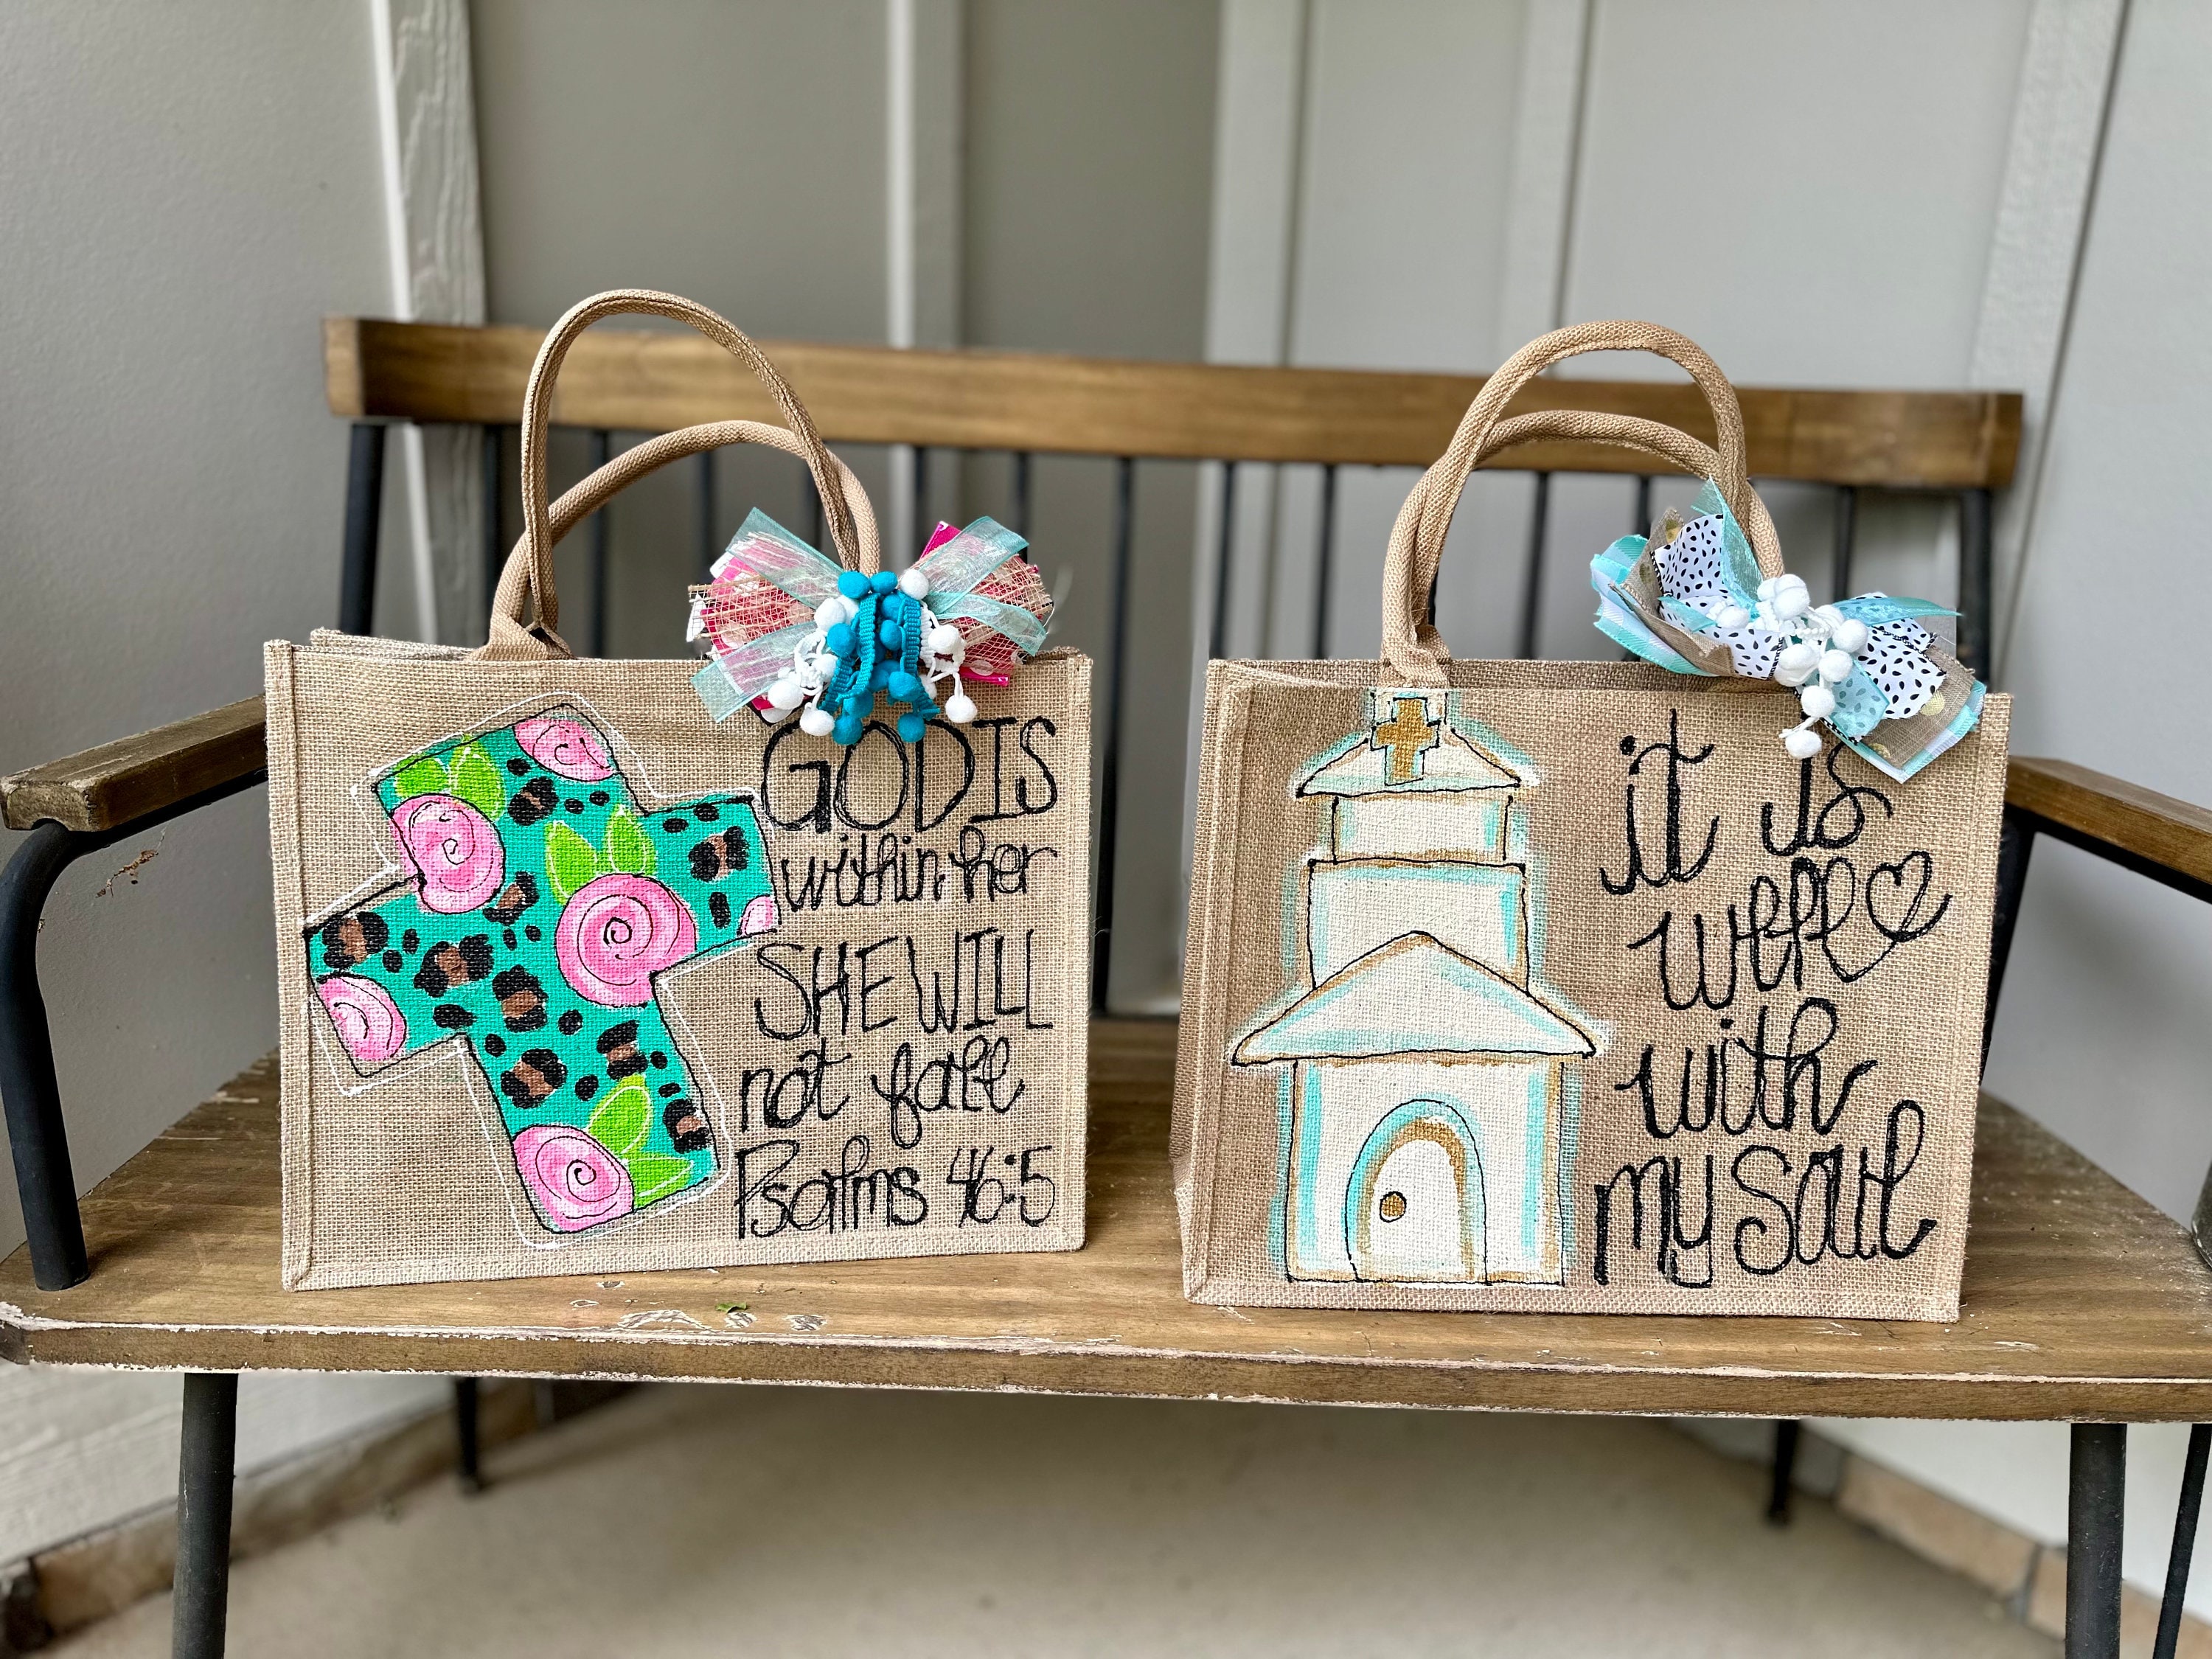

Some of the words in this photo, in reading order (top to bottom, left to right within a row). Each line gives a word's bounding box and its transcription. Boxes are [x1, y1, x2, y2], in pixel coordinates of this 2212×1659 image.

[968, 717, 1058, 824] IS
[1599, 708, 1720, 895] it
[781, 832, 945, 912] within
[949, 825, 1058, 903] her
[754, 935, 900, 1040] SHE
[906, 927, 1053, 1034] WILL
[1627, 855, 1896, 1011] well
[741, 1037, 852, 1133] not
[871, 1034, 1025, 1150] fall
[1615, 996, 1878, 1139] with
[734, 1135, 929, 1239] Psalms
[946, 1145, 1056, 1228] 46:5
[1593, 1154, 1714, 1289] my
